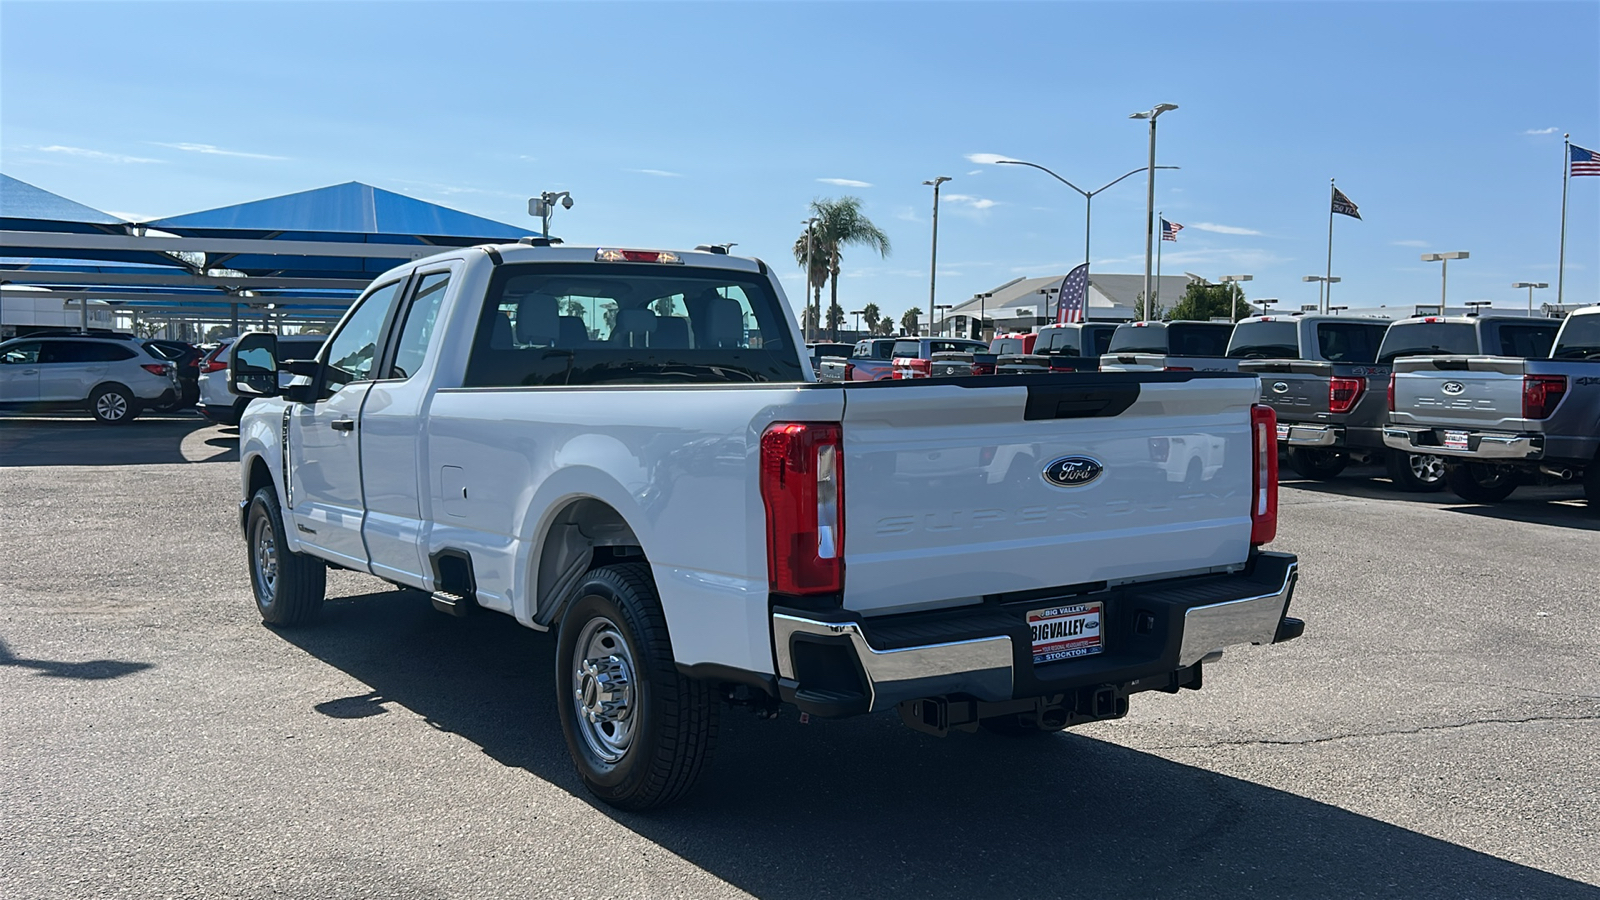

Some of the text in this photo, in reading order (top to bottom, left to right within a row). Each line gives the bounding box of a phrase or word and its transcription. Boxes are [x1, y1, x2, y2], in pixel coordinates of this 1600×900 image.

[1059, 461, 1092, 481] Ford
[874, 502, 1089, 537] SUPER
[1060, 606, 1085, 614] VALLEY
[1031, 619, 1085, 641] BIGVALLEY
[1045, 649, 1087, 660] STOCKTON
